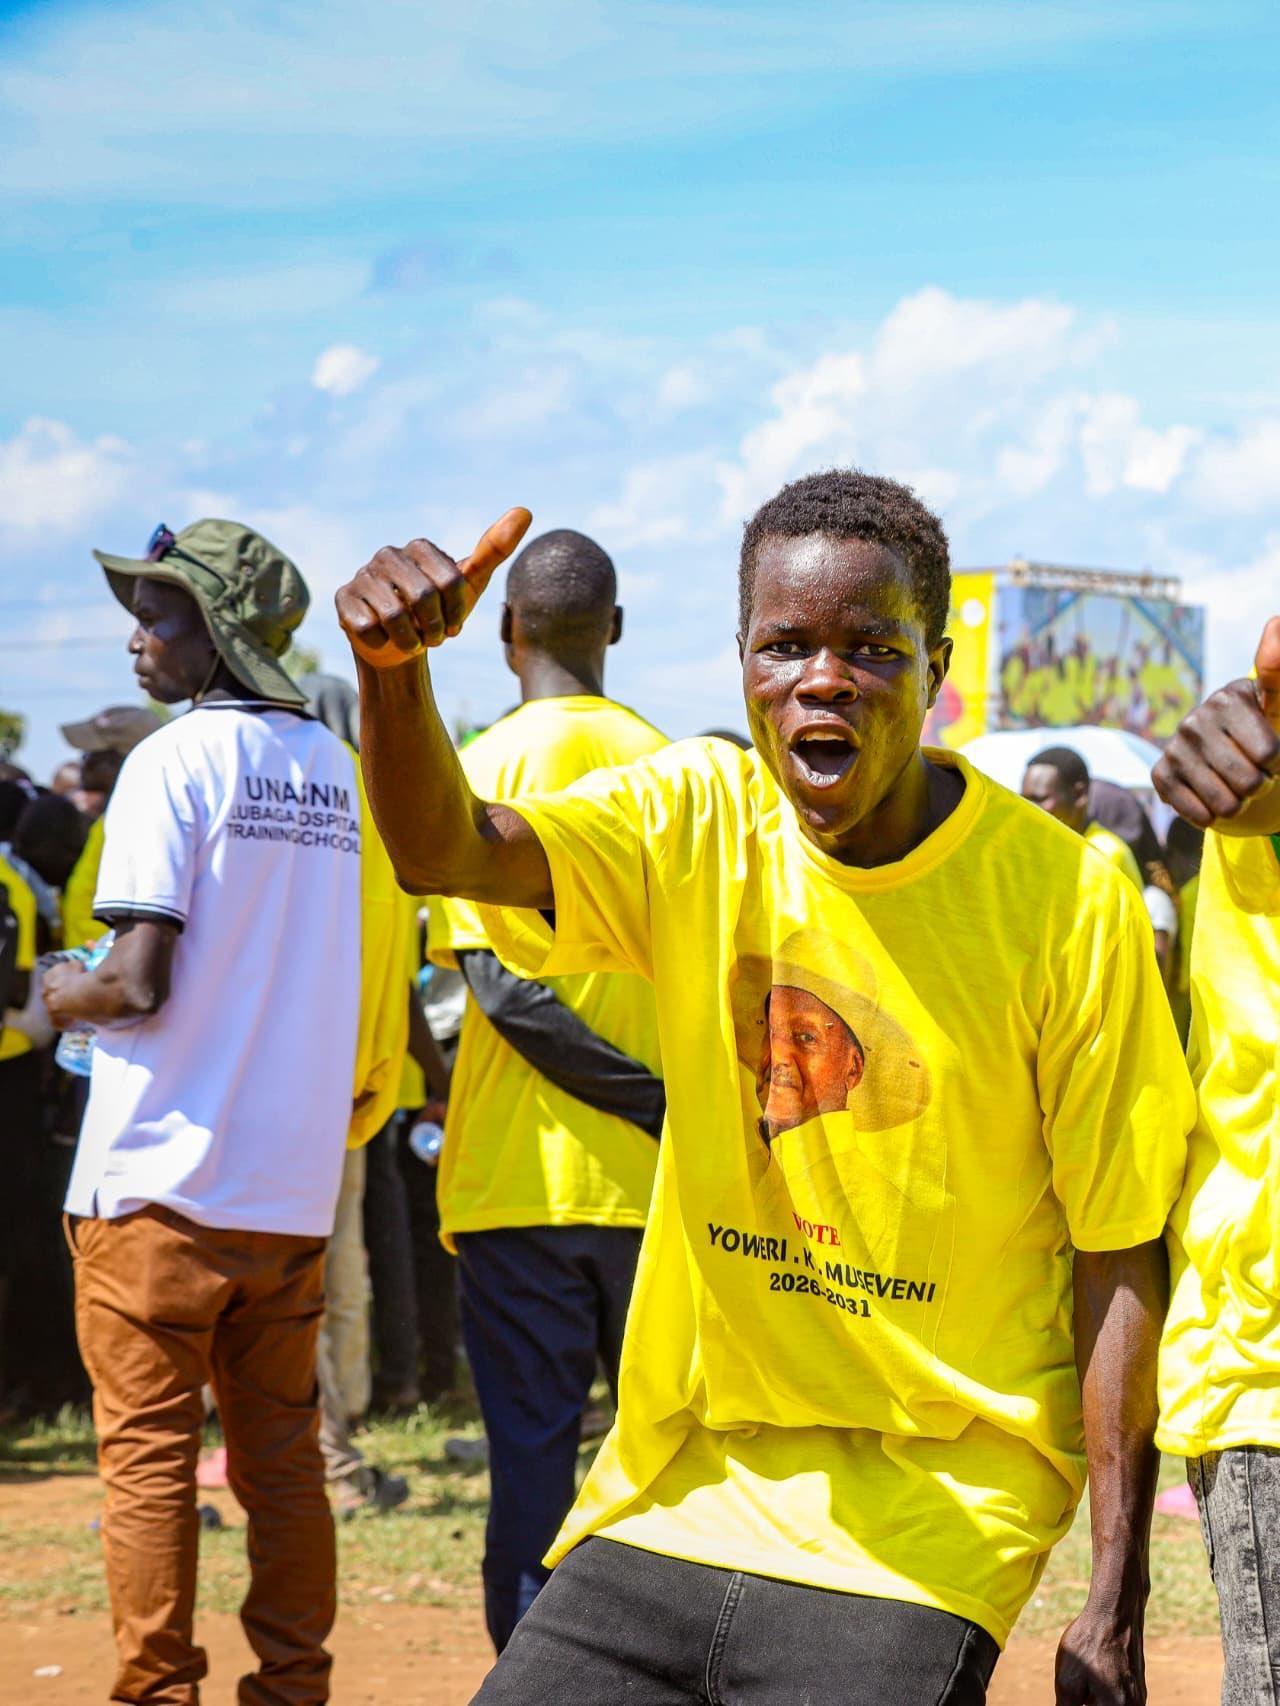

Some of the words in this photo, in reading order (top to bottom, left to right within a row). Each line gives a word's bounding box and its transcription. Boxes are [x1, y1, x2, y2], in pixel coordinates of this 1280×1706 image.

[298, 810, 361, 835] OSPITA
[299, 831, 361, 855] CHOOL
[791, 1210, 841, 1247] VOTE
[769, 1271, 872, 1318] 2026-2031
[825, 1260, 937, 1303] MUSEVENI
